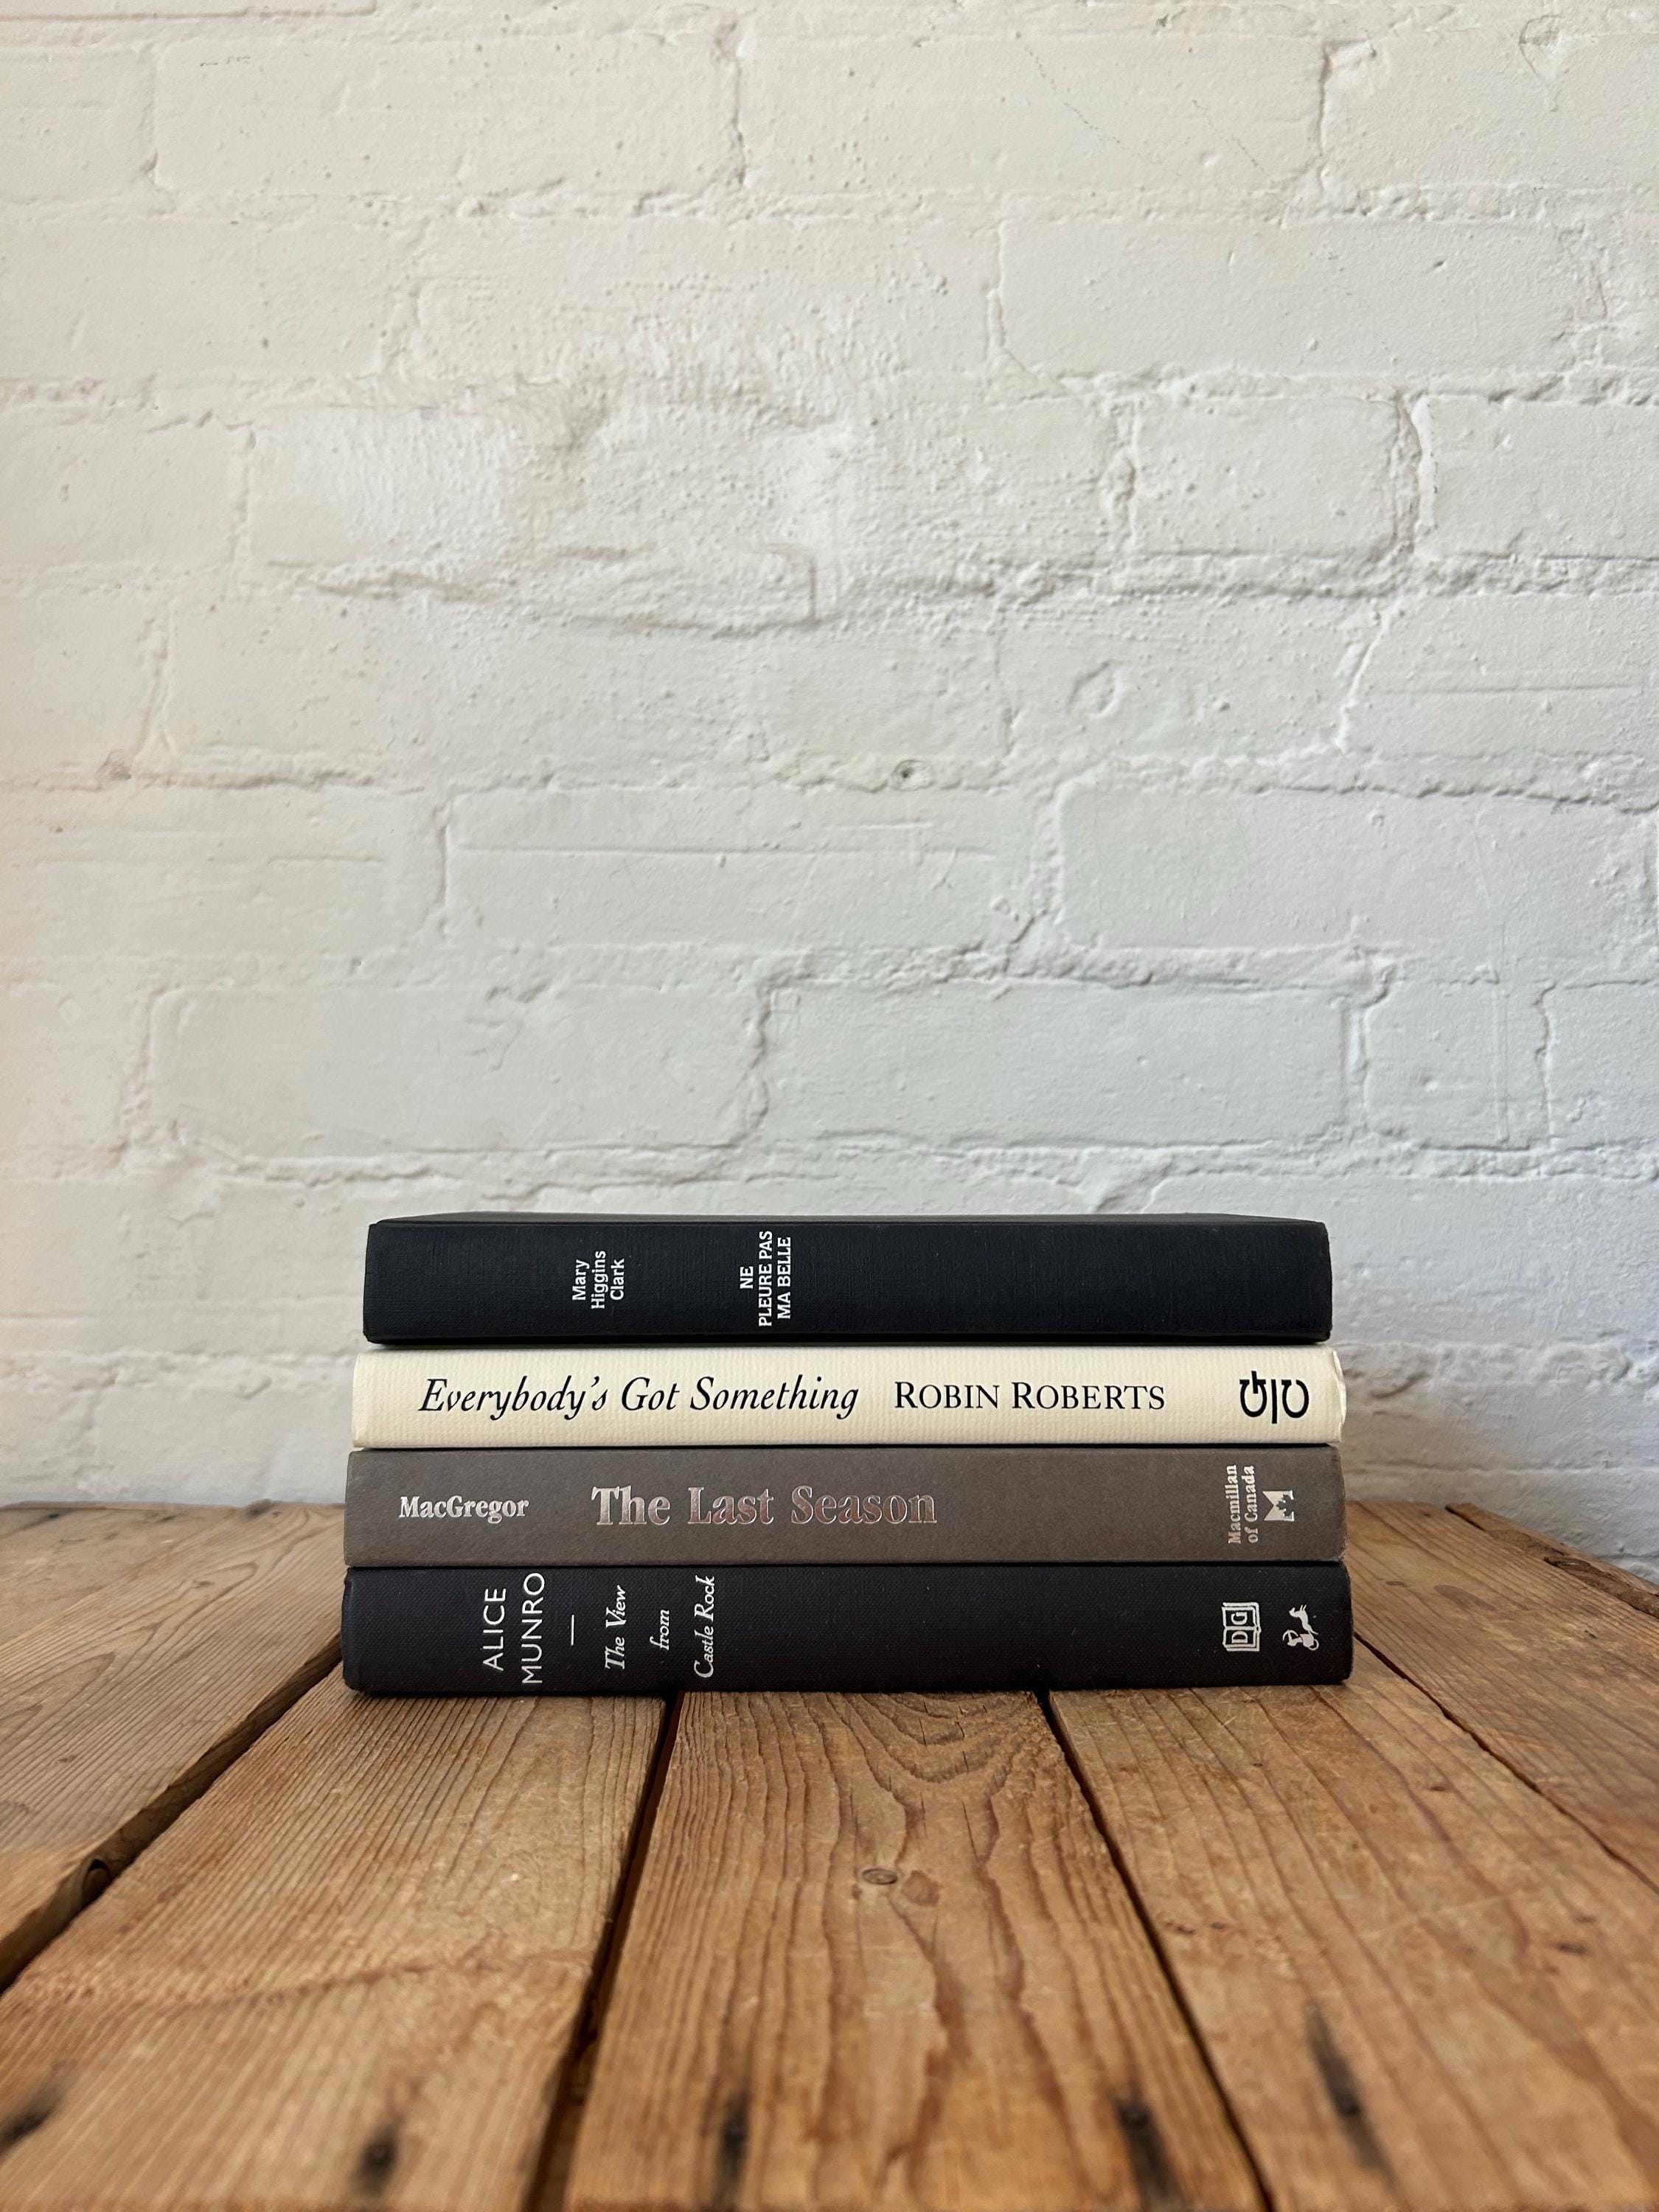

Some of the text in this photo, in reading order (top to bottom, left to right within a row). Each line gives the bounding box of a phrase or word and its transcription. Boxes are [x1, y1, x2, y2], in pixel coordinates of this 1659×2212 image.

[571, 1259, 590, 1301] Mary
[591, 1250, 609, 1310] Higgins
[610, 1258, 625, 1301] Clark
[740, 1266, 754, 1290] NE
[758, 1231, 773, 1326] PLEURE PAS
[776, 1237, 791, 1319] MA BELLE
[417, 1374, 859, 1421] Everybody's Got Something
[894, 1381, 1165, 1411] ROBIN ROBERTS
[398, 1495, 529, 1524] MacGregor
[591, 1485, 937, 1526] The Last Season
[1227, 1464, 1241, 1544] Macmillan
[1242, 1465, 1259, 1543] of Canada
[482, 1588, 507, 1672] ALICE
[521, 1572, 546, 1684] MUNRO
[604, 1585, 627, 1670] The View
[649, 1609, 669, 1650] from
[693, 1574, 715, 1678] Castle Rock
